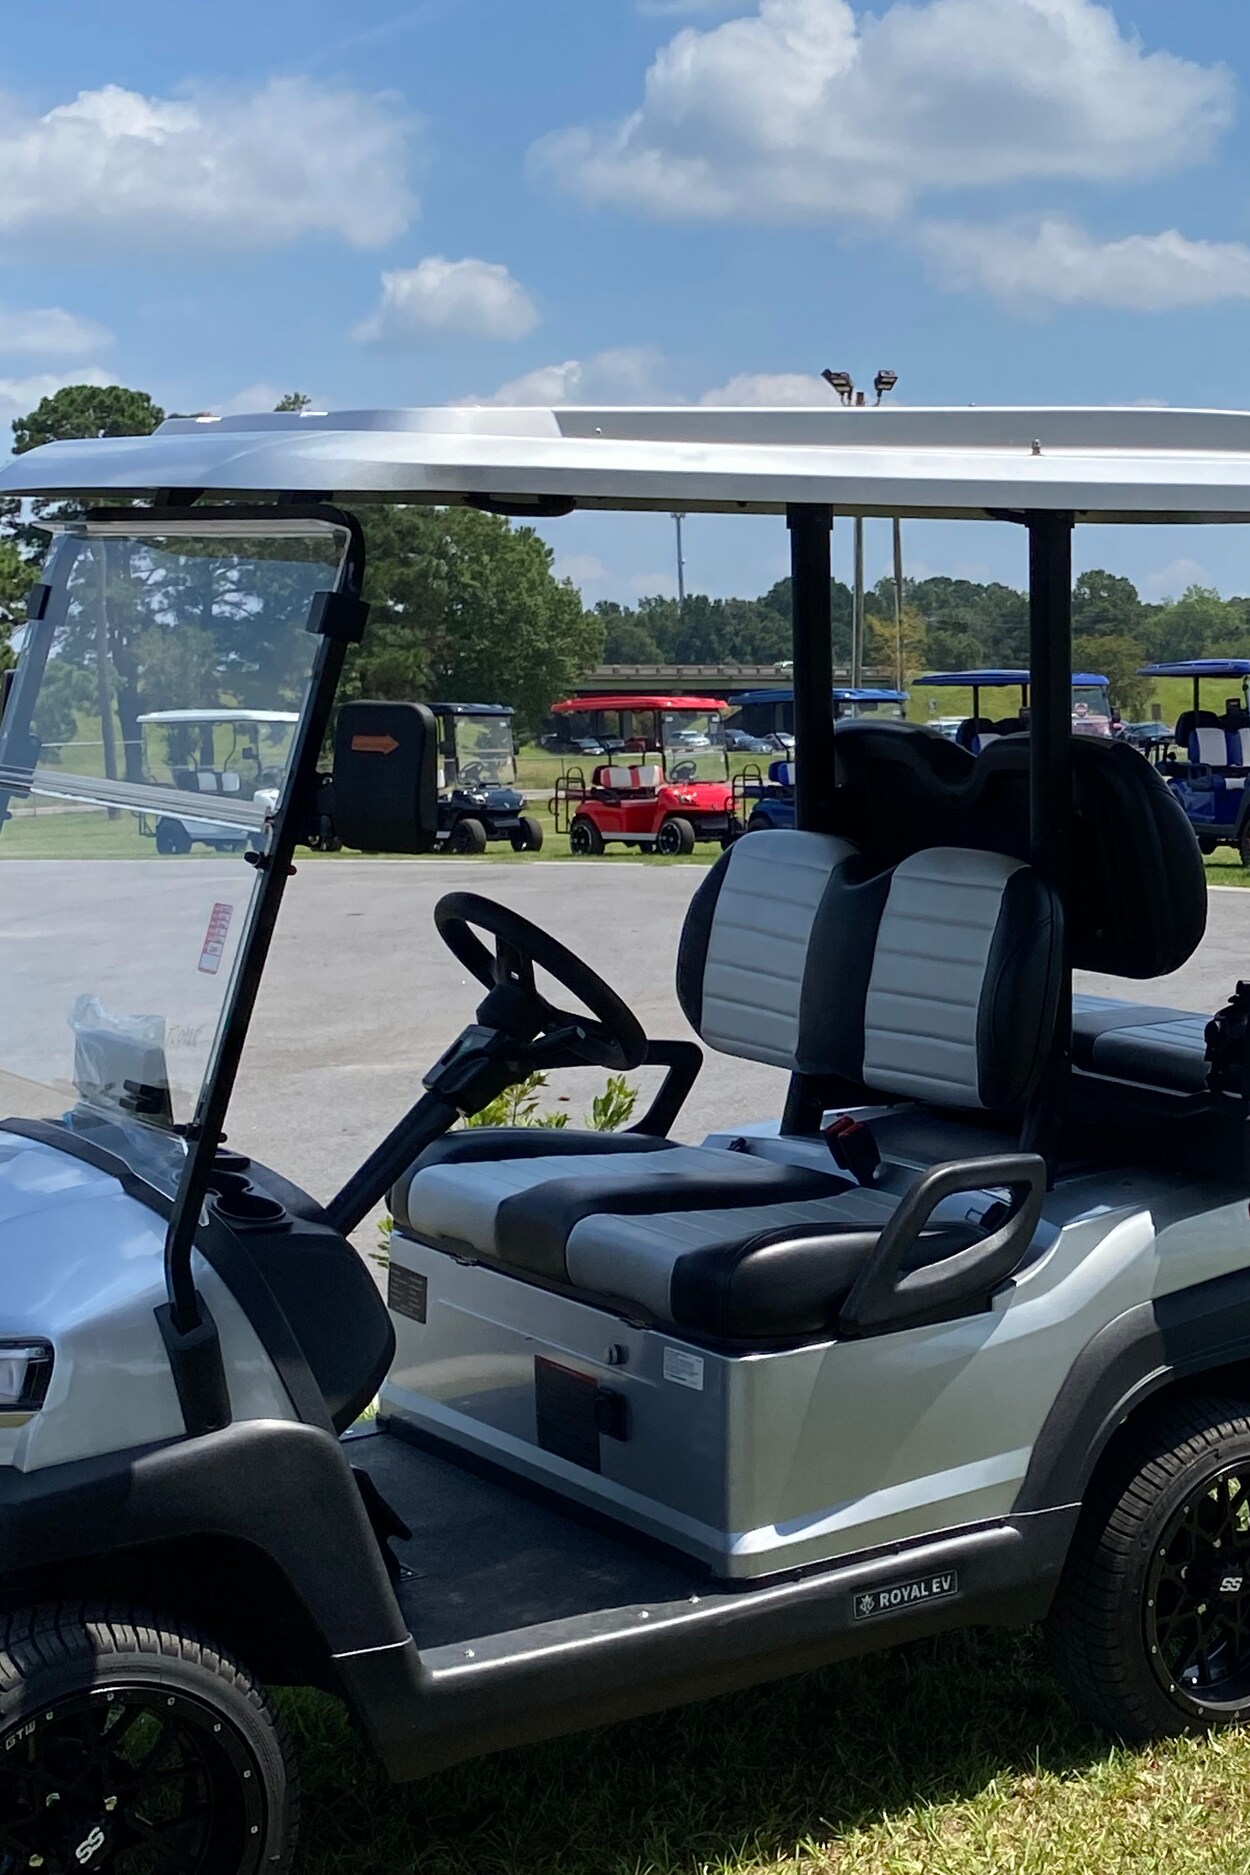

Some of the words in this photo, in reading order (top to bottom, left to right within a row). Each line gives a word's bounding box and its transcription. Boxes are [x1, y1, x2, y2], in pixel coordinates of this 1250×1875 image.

[880, 1582, 929, 1608] ROYAL
[932, 1575, 951, 1593] EV
[1219, 1577, 1243, 1592] SS
[5, 1719, 36, 1751] GTW
[75, 1826, 105, 1864] SS
